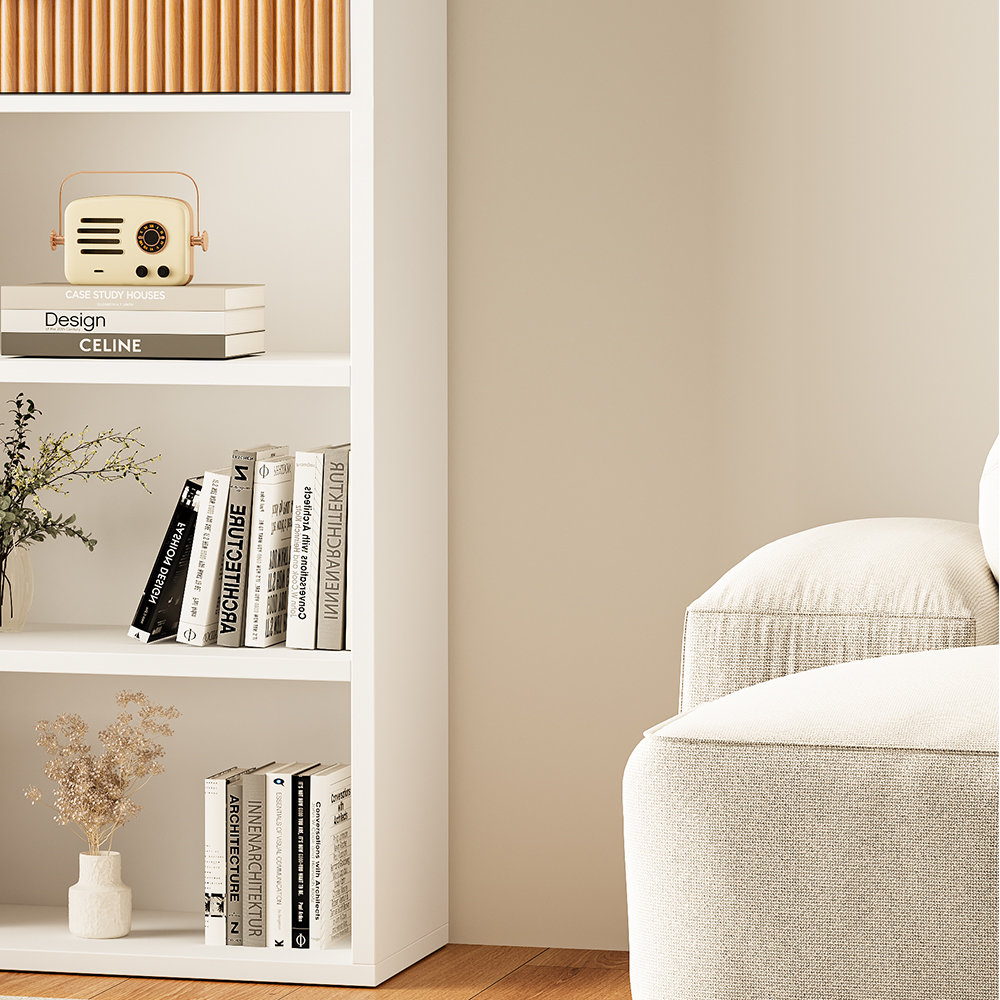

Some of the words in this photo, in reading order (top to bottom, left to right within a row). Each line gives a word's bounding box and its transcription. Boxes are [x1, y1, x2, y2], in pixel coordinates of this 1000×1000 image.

[65, 290, 90, 299] CASE
[93, 290, 124, 299] STUDY
[126, 291, 165, 300] HOUSES
[46, 312, 105, 331] Design
[80, 338, 141, 352] CELINE
[230, 794, 240, 902] ARCHITECTURE
[248, 801, 262, 937] INNENARCHITEKTUR
